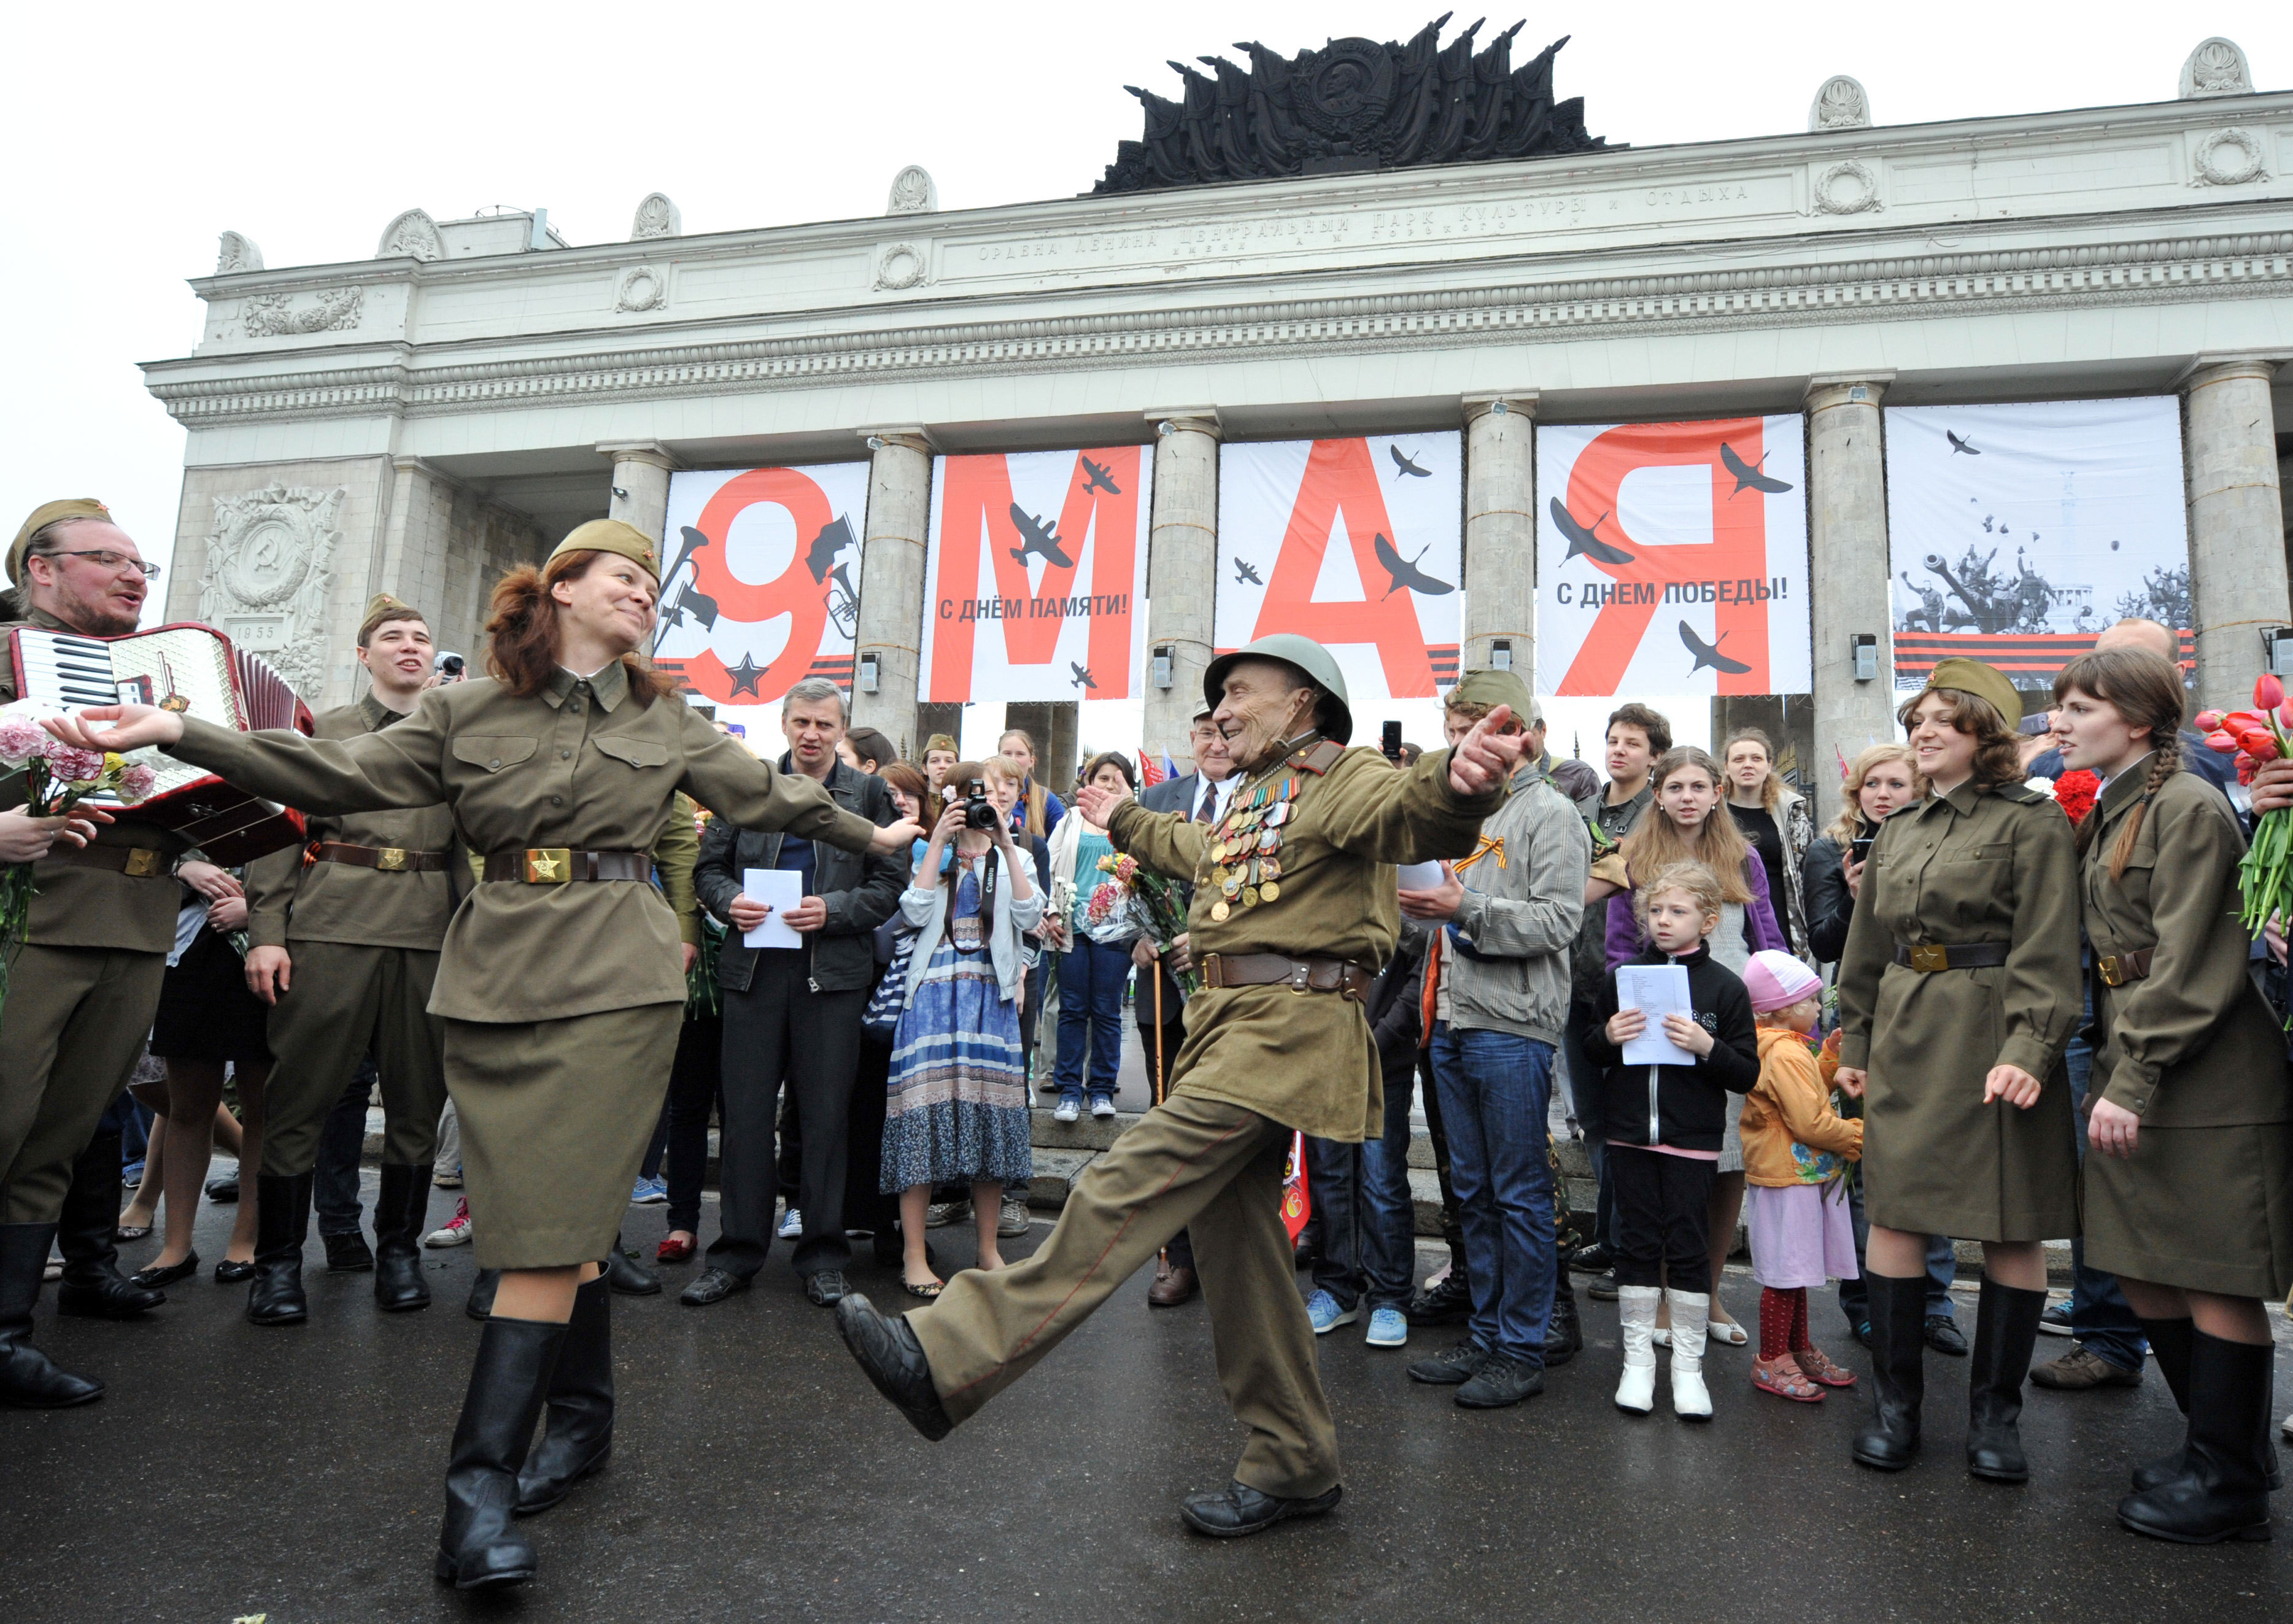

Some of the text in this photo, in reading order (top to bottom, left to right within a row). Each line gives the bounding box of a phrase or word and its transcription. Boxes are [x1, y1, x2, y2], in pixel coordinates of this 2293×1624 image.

[978, 243, 1058, 261] ОРДЕНА
[1075, 234, 1157, 253] ЛЕНИНА
[1373, 211, 1434, 228] ПАРК
[1458, 199, 1586, 222] КУЛЬТУРЫ
[1645, 186, 1748, 206] ОТДЫХА
[690, 467, 833, 705] 9
[1556, 578, 1788, 609] С ДНЕМ ПОБЕДЫ!
[940, 594, 1127, 622] С ДНЁМ ПАМЯТИ!
[237, 627, 274, 639] 1955
[986, 867, 994, 893] Canon
